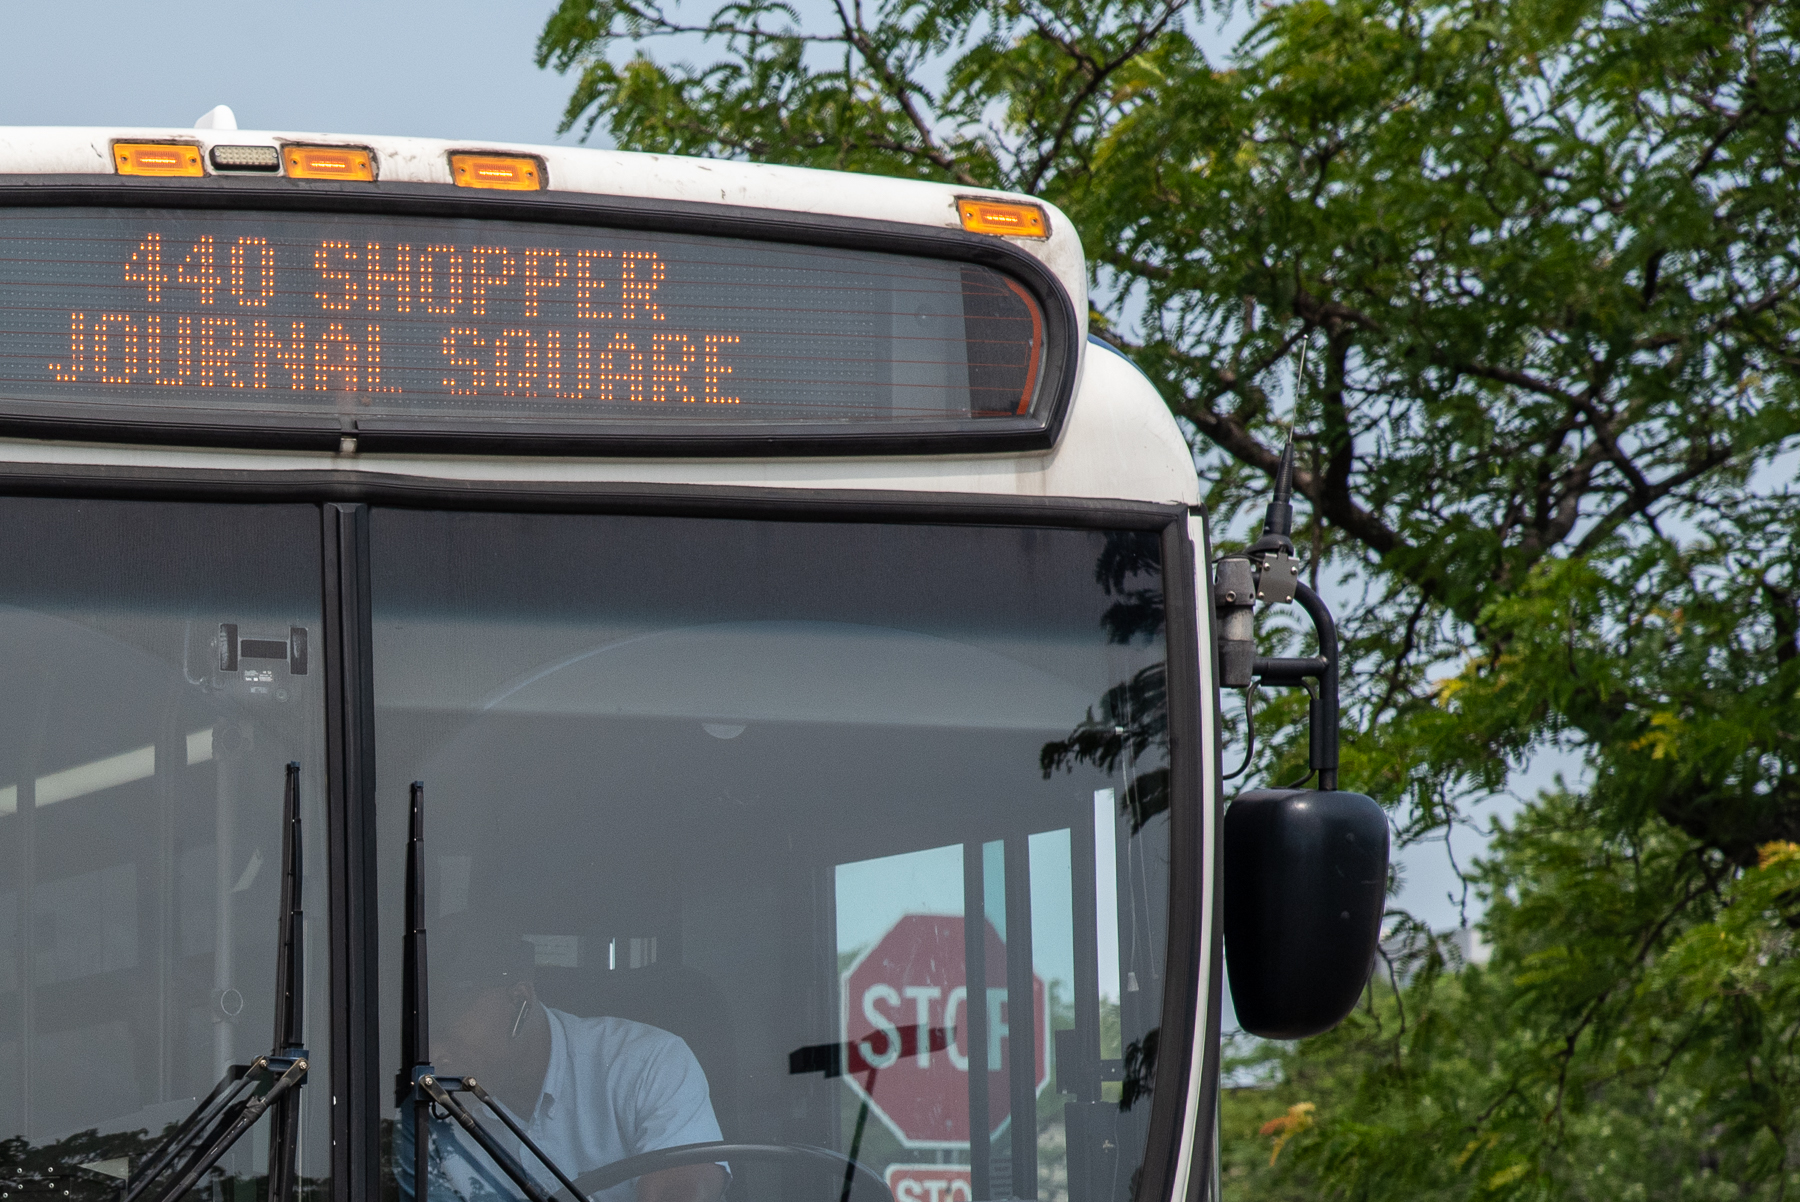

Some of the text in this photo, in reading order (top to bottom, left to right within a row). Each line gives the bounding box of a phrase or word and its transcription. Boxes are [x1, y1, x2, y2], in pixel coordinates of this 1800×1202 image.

[124, 232, 666, 321] 440 SHOPPER
[48, 312, 741, 404] JOURNAL SQUARE
